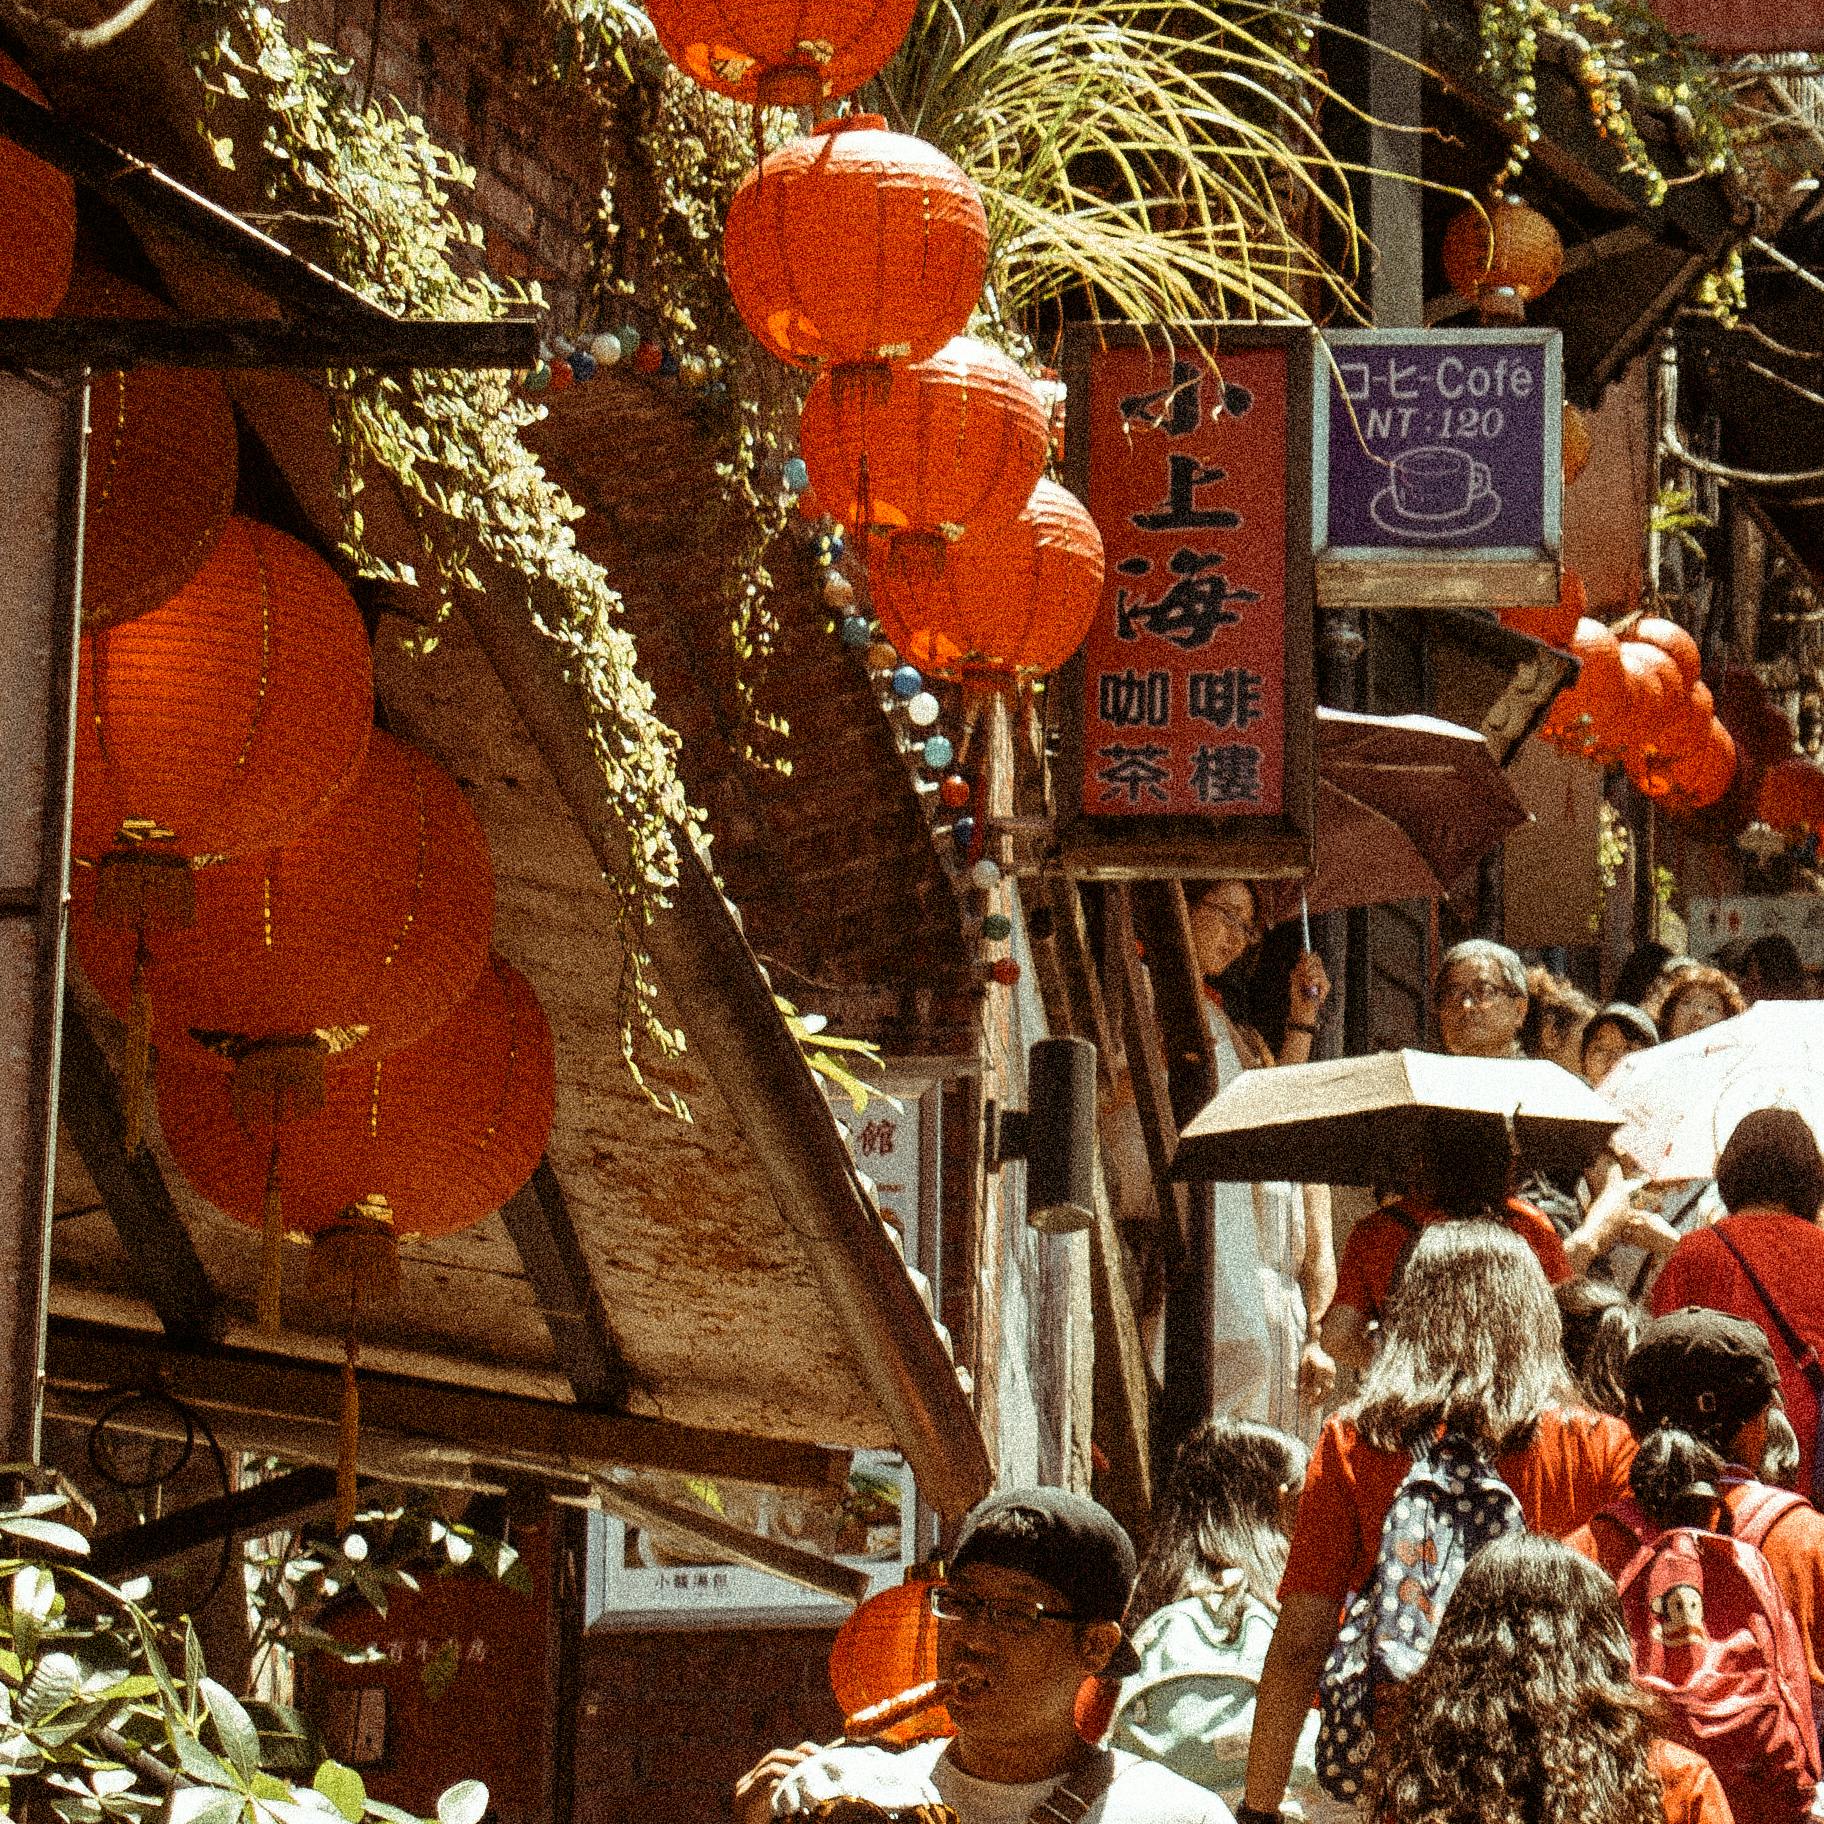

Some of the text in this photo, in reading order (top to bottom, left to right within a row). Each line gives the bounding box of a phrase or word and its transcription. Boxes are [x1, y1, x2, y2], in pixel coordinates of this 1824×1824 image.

[1118, 362, 1260, 648] 小上海
[1098, 670, 1264, 729] 咖啡
[1097, 743, 1263, 805] 茶樓
